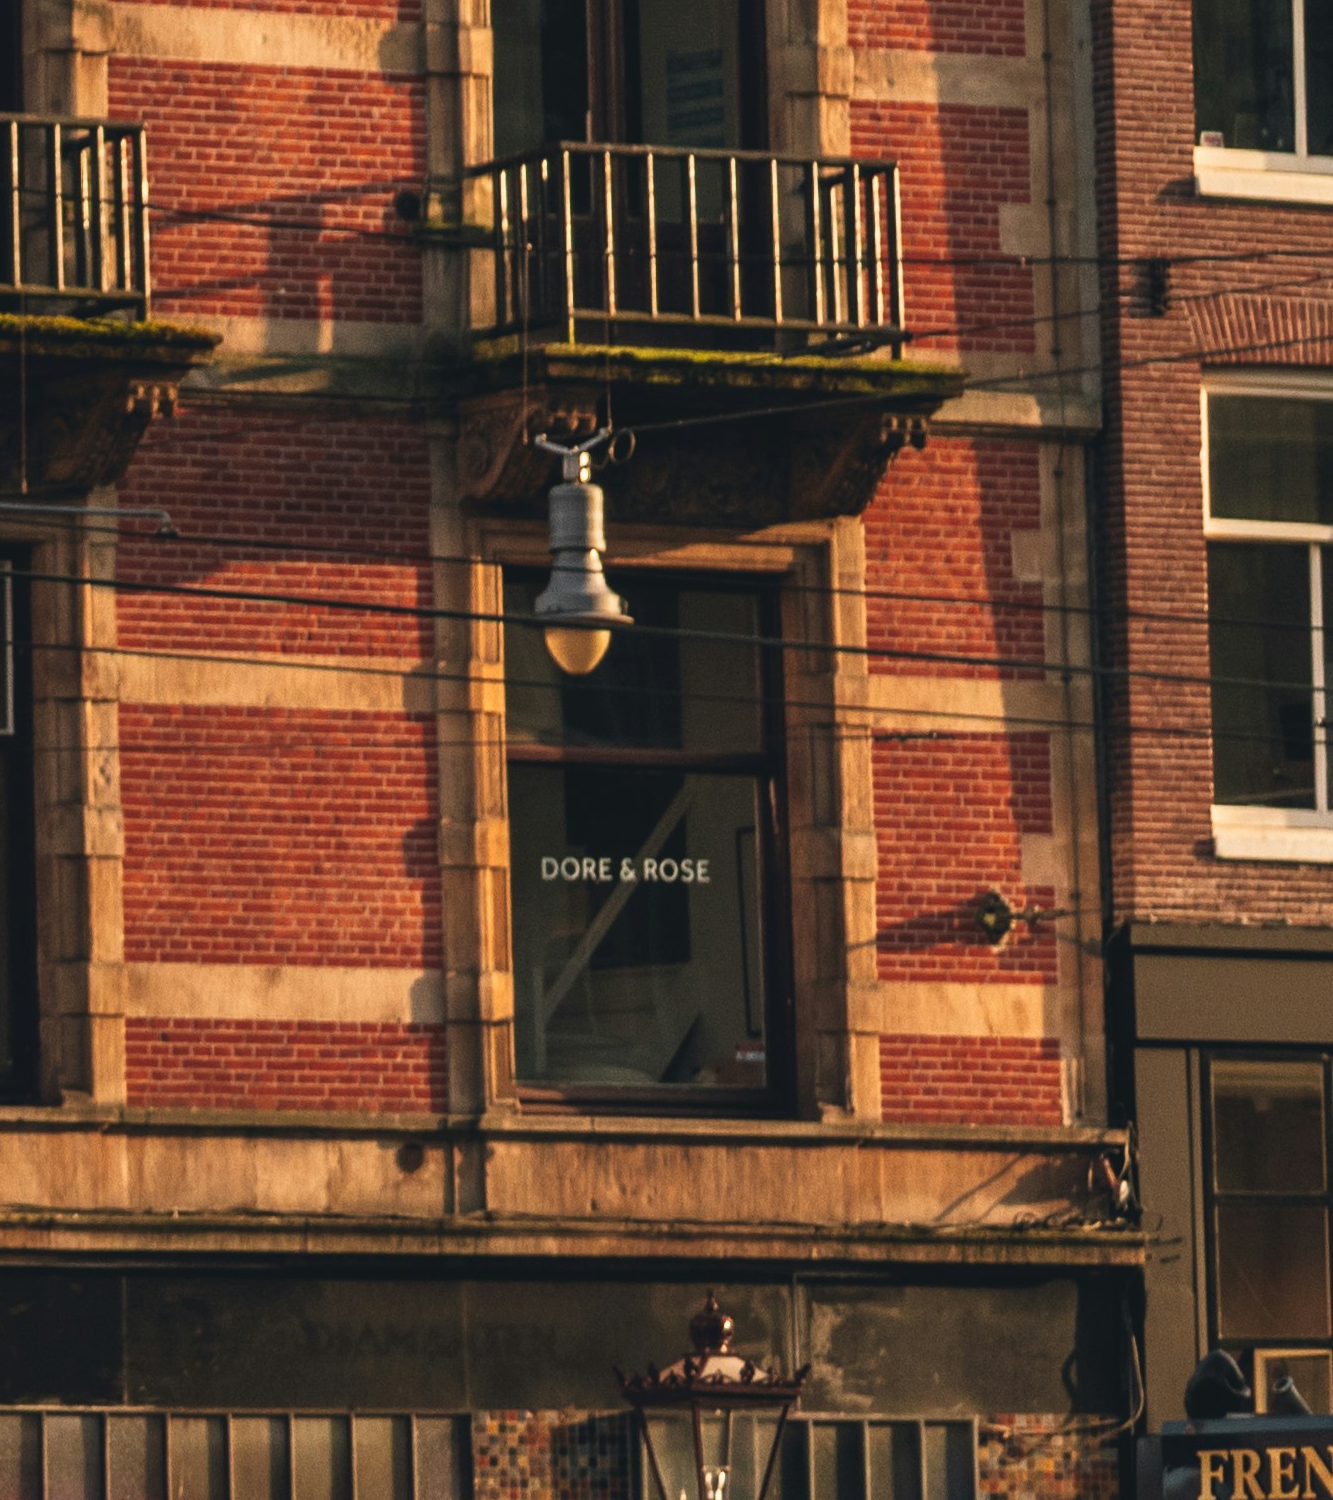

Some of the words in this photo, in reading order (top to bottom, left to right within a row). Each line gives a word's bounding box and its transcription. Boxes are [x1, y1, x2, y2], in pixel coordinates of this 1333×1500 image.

[541, 856, 613, 882] DORE
[620, 857, 636, 882] &
[644, 858, 710, 884] ROSE
